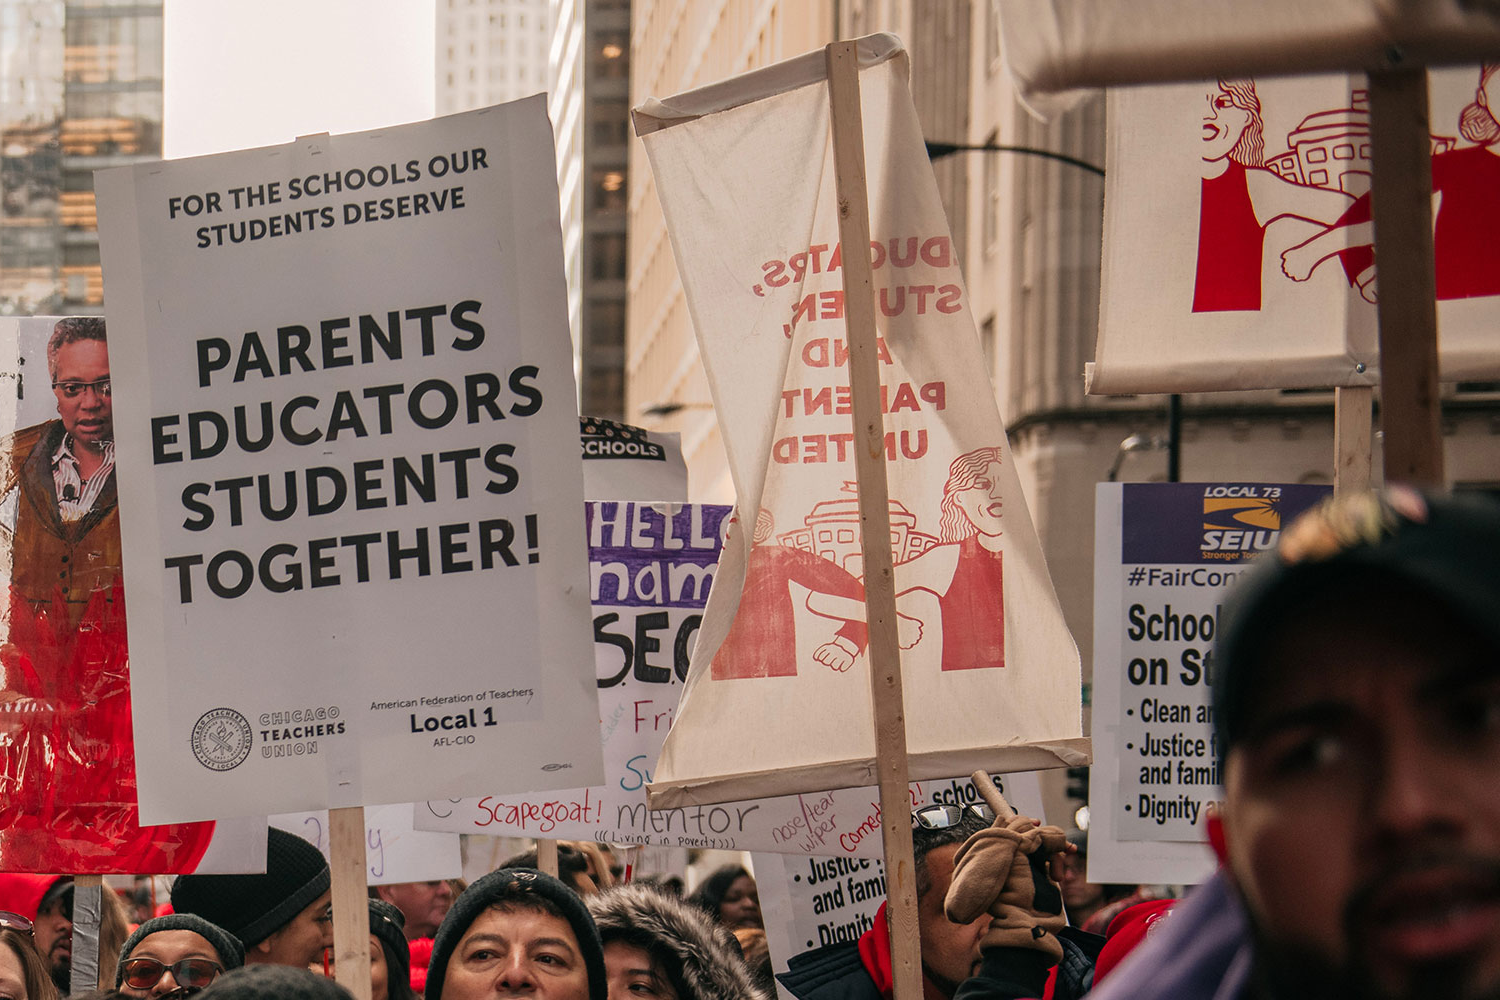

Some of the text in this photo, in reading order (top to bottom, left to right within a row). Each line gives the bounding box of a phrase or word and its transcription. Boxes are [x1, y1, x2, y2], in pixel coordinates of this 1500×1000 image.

[169, 147, 489, 220] FOR THE SCHOOLS OUR
[196, 186, 466, 249] STUDENTS DESERVE
[196, 299, 486, 389] PARENTS
[150, 365, 544, 466] EDUCATORS
[181, 443, 520, 532] STUDENTS
[1204, 486, 1281, 498] LOCAL 73
[590, 501, 734, 550] HELL
[1200, 530, 1280, 551] SEIU
[164, 513, 541, 604] TOGETHER!
[1202, 551, 1240, 561] Stronger
[1128, 567, 1244, 587] #FairCon
[1127, 657, 1168, 686] on
[370, 687, 534, 711] American Federation of Teachers
[1140, 698, 1191, 723] Clean
[258, 706, 341, 726] CHICAGO
[410, 706, 498, 733] Local 1
[260, 722, 346, 742] TEACHERS
[433, 734, 476, 748] AFL-CIO
[1139, 732, 1205, 757] Justice
[261, 741, 318, 759] UNION
[1139, 761, 1172, 785] and
[474, 787, 602, 833] Scapegoat!
[1138, 794, 1202, 825] Dignity
[659, 835, 670, 845] in
[813, 883, 845, 915] and
